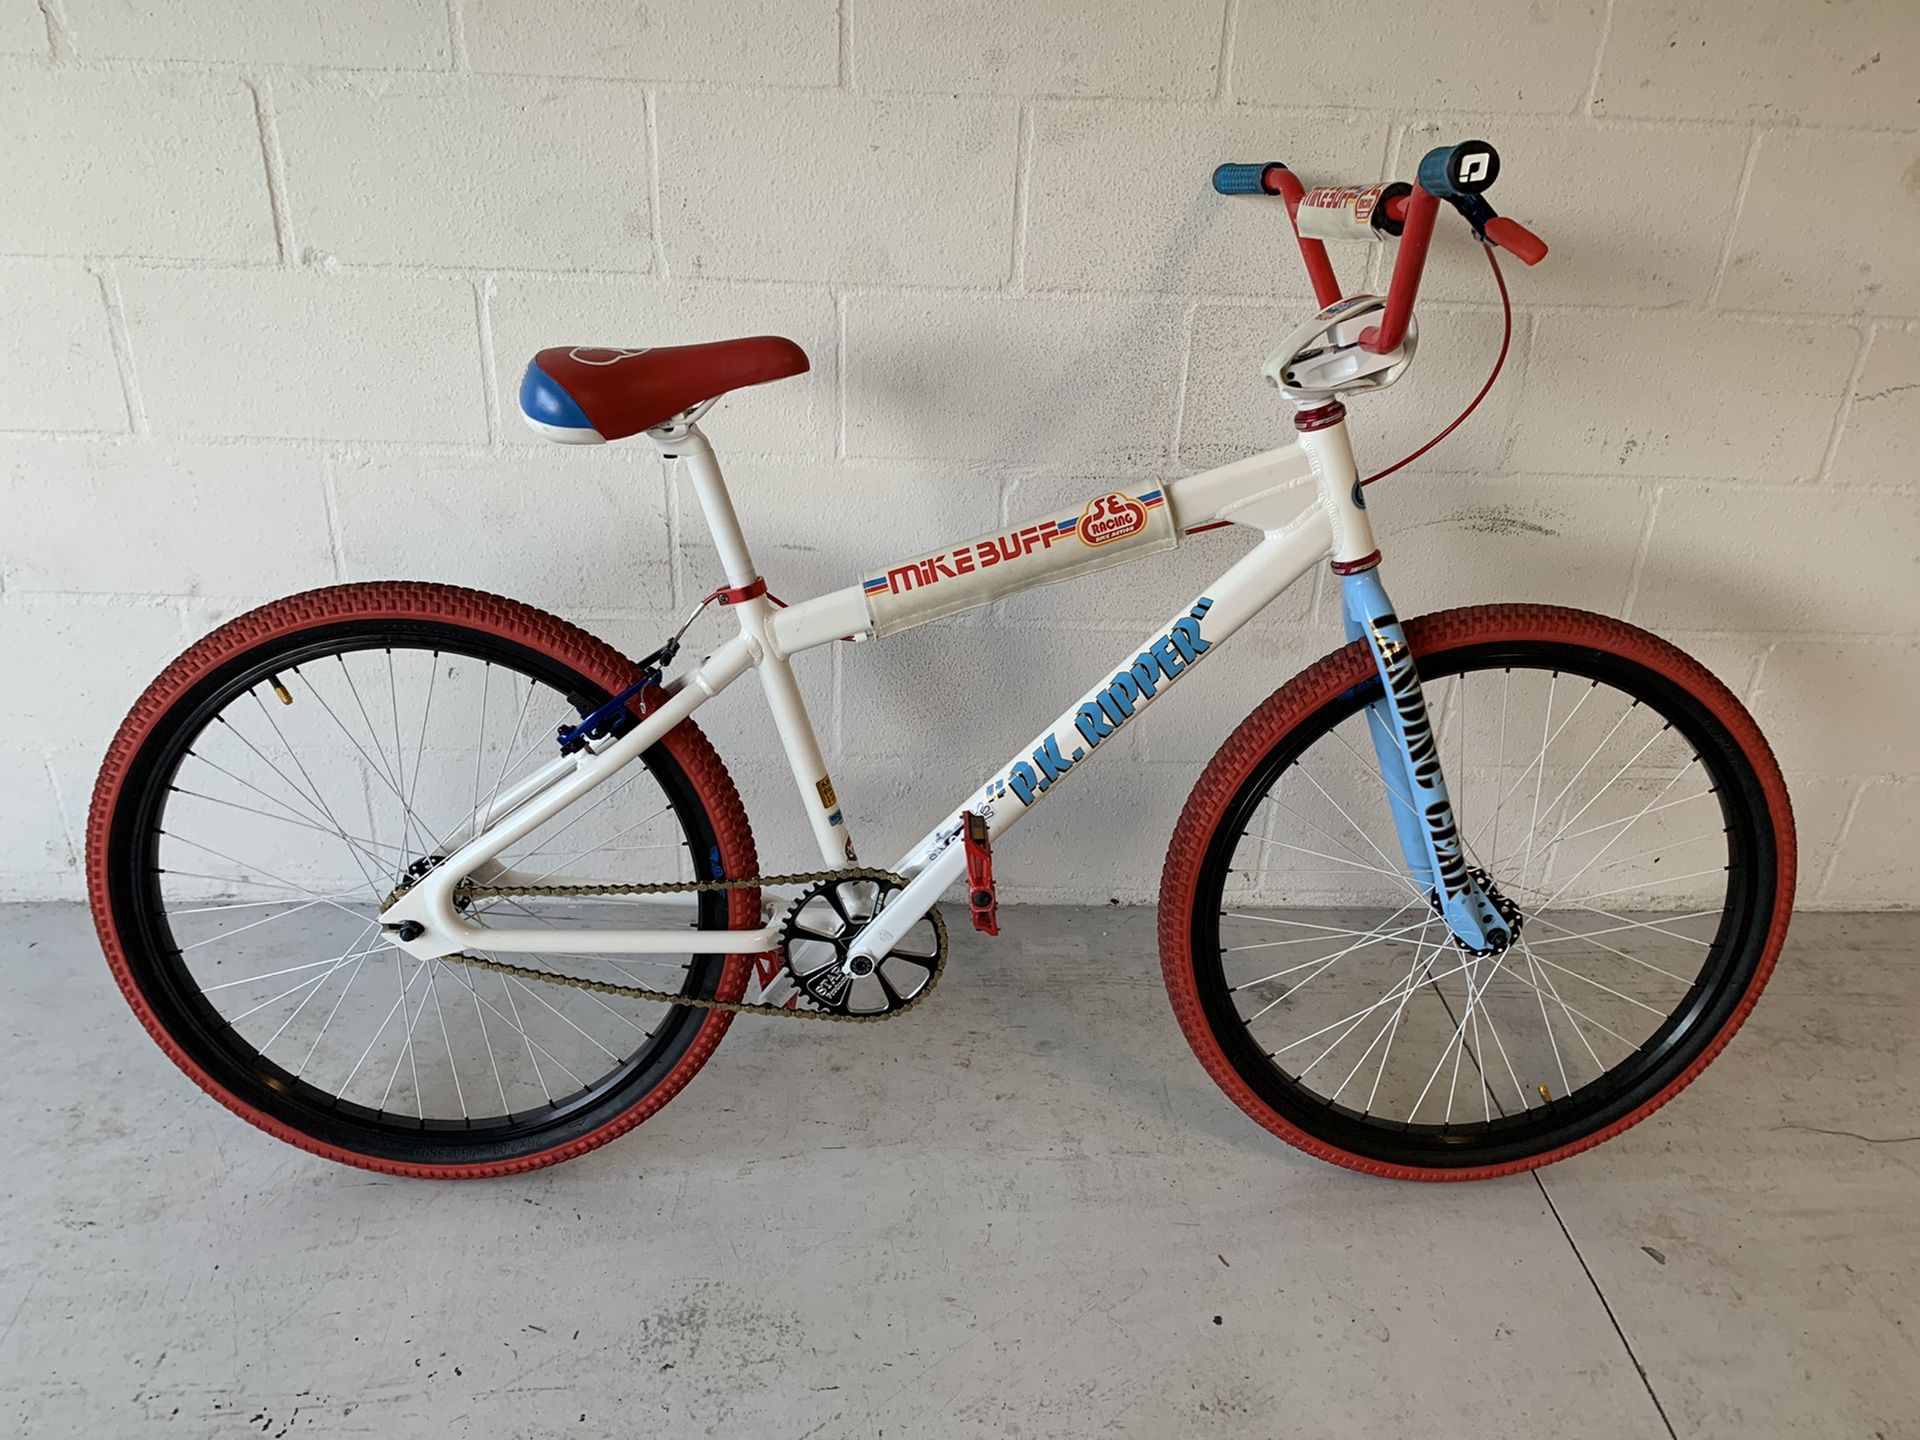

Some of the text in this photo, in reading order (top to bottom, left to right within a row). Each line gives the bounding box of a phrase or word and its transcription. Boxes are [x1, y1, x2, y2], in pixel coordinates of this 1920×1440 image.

[1091, 513, 1133, 535] RACING
[976, 520, 1060, 569] BUFF
[815, 966, 842, 996] STAR
